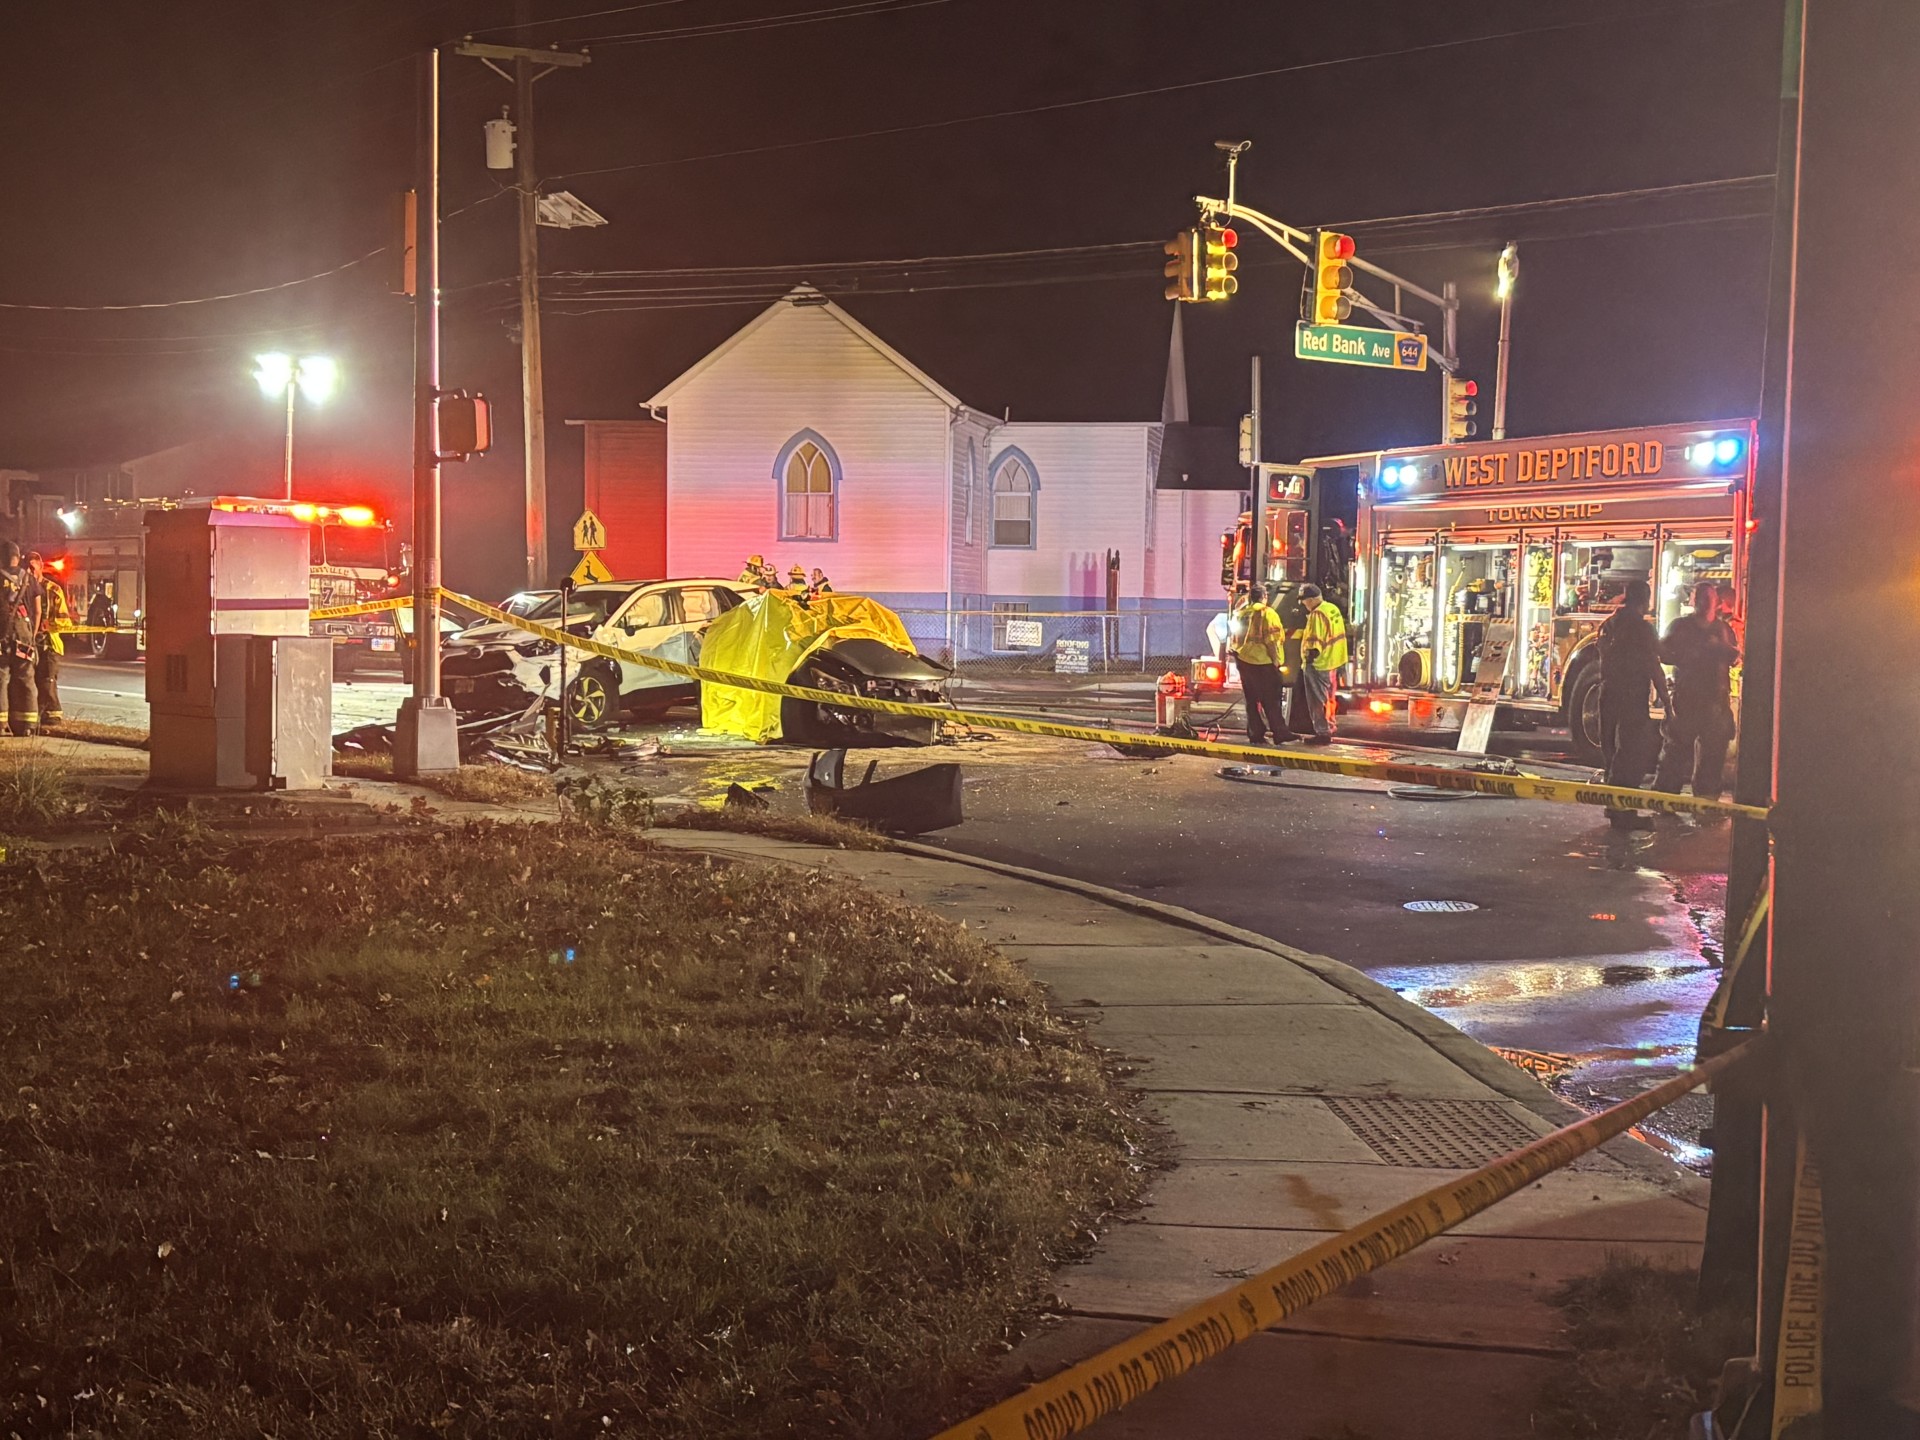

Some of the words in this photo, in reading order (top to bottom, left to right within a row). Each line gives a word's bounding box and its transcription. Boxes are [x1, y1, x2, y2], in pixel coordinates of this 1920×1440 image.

[1303, 331, 1328, 352] Red
[1332, 334, 1366, 356] Bank
[1371, 343, 1390, 358] Ave
[1401, 345, 1418, 358] 644
[1443, 453, 1509, 487] WEST
[1516, 440, 1663, 483] DEPTFORD
[1485, 503, 1603, 523] TOWNSHIP
[322, 587, 334, 605] 7
[1789, 1272, 1819, 1315] LINE
[1784, 1319, 1817, 1388] POLICE
